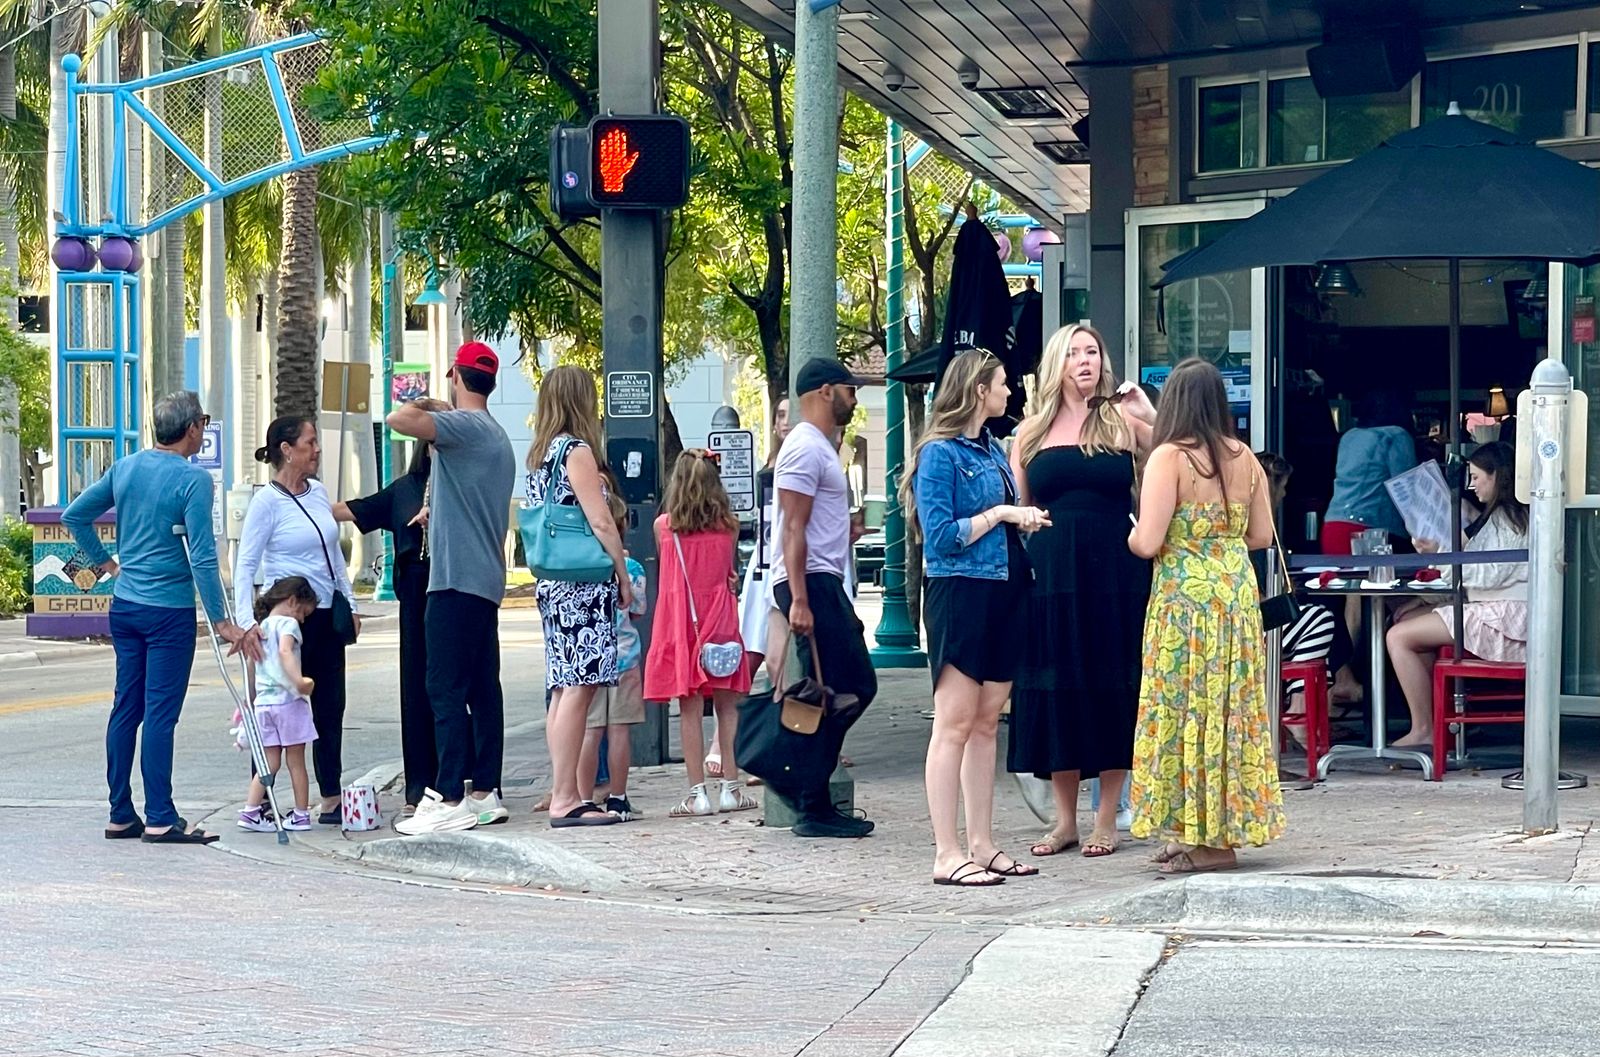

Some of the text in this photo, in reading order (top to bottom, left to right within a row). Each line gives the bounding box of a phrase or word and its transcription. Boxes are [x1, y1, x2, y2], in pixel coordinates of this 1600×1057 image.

[1472, 82, 1527, 118] 201
[201, 438, 212, 454] P
[43, 527, 116, 540] PINPL
[49, 598, 111, 611] GROV
